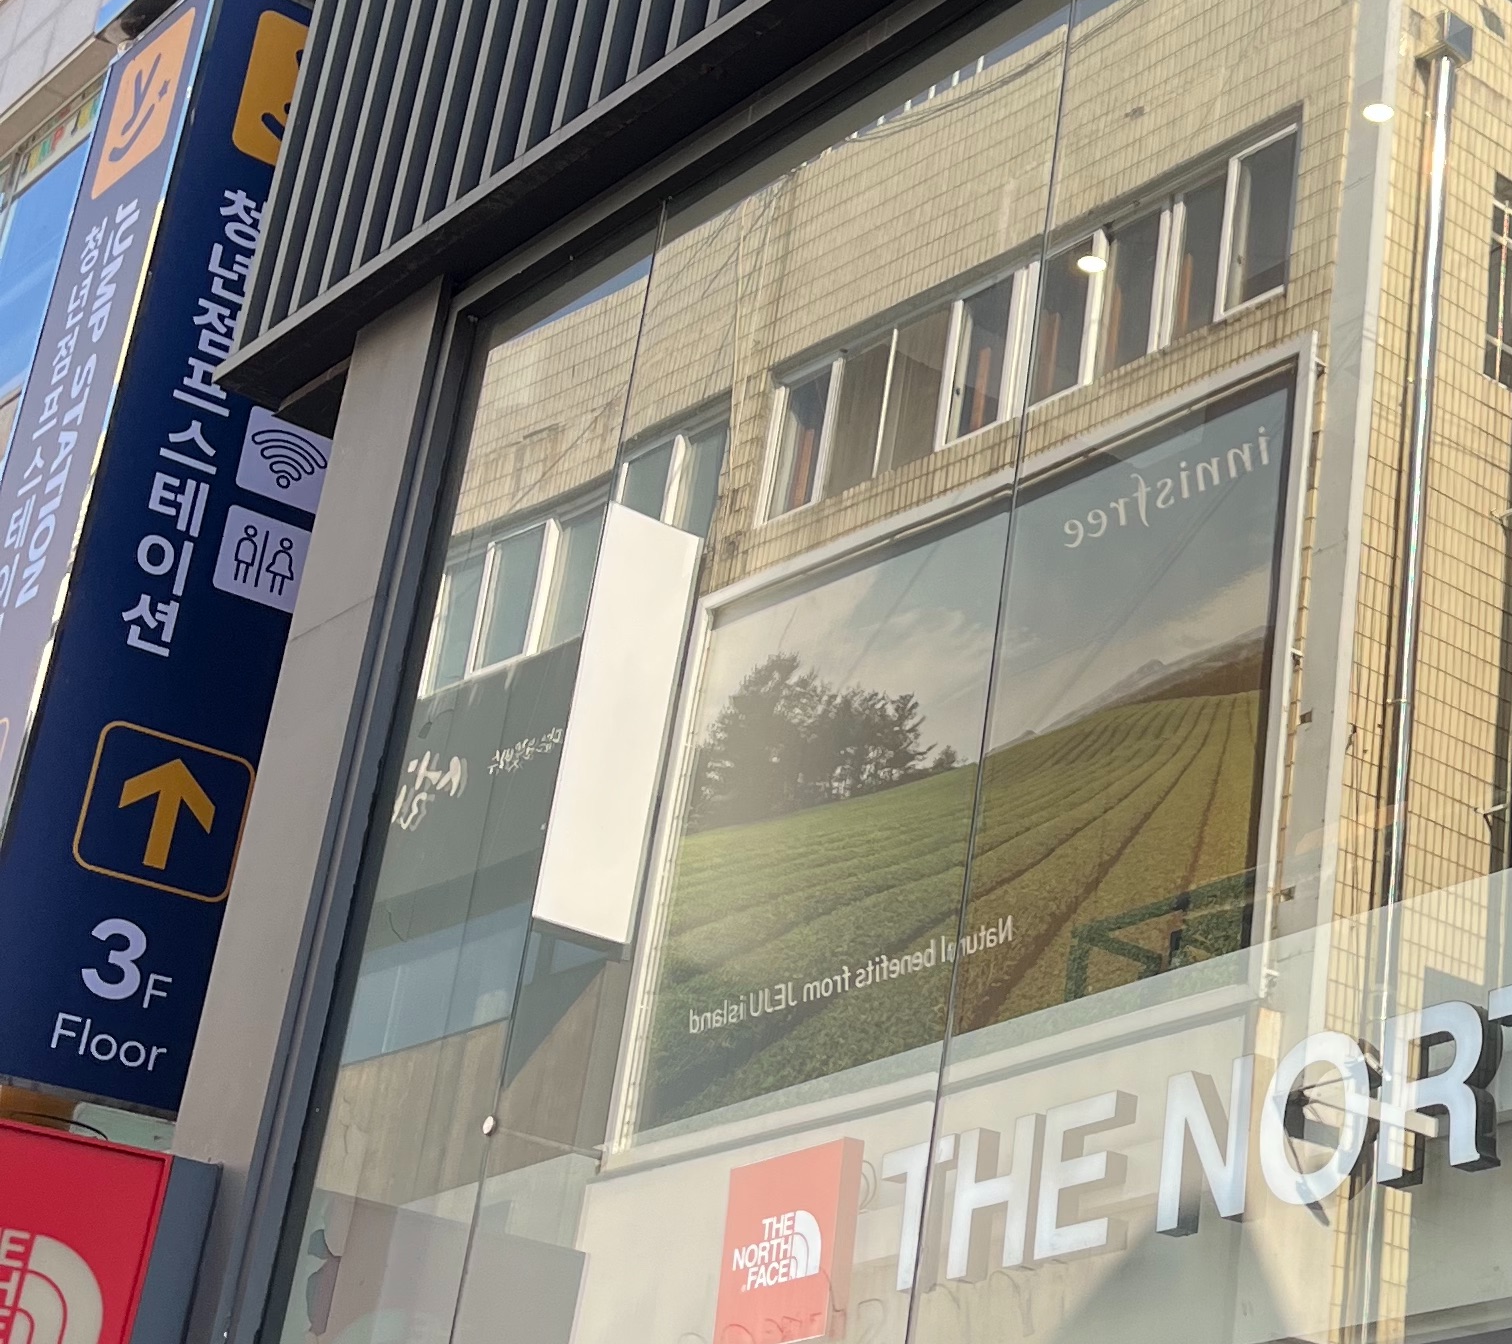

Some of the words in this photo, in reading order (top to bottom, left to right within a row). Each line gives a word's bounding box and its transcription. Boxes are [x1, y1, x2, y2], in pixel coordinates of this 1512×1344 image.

[88, 198, 141, 344] JUMP
[0, 216, 108, 628] 청년점프스테이
[15, 353, 98, 609] STATION
[121, 190, 266, 657] 청년점프스테이션
[50, 1013, 167, 1071] Floor
[732, 1235, 793, 1271] NORTH
[762, 1212, 795, 1241] THE
[882, 1089, 1122, 1290] THE
[746, 1258, 790, 1291] FACE
